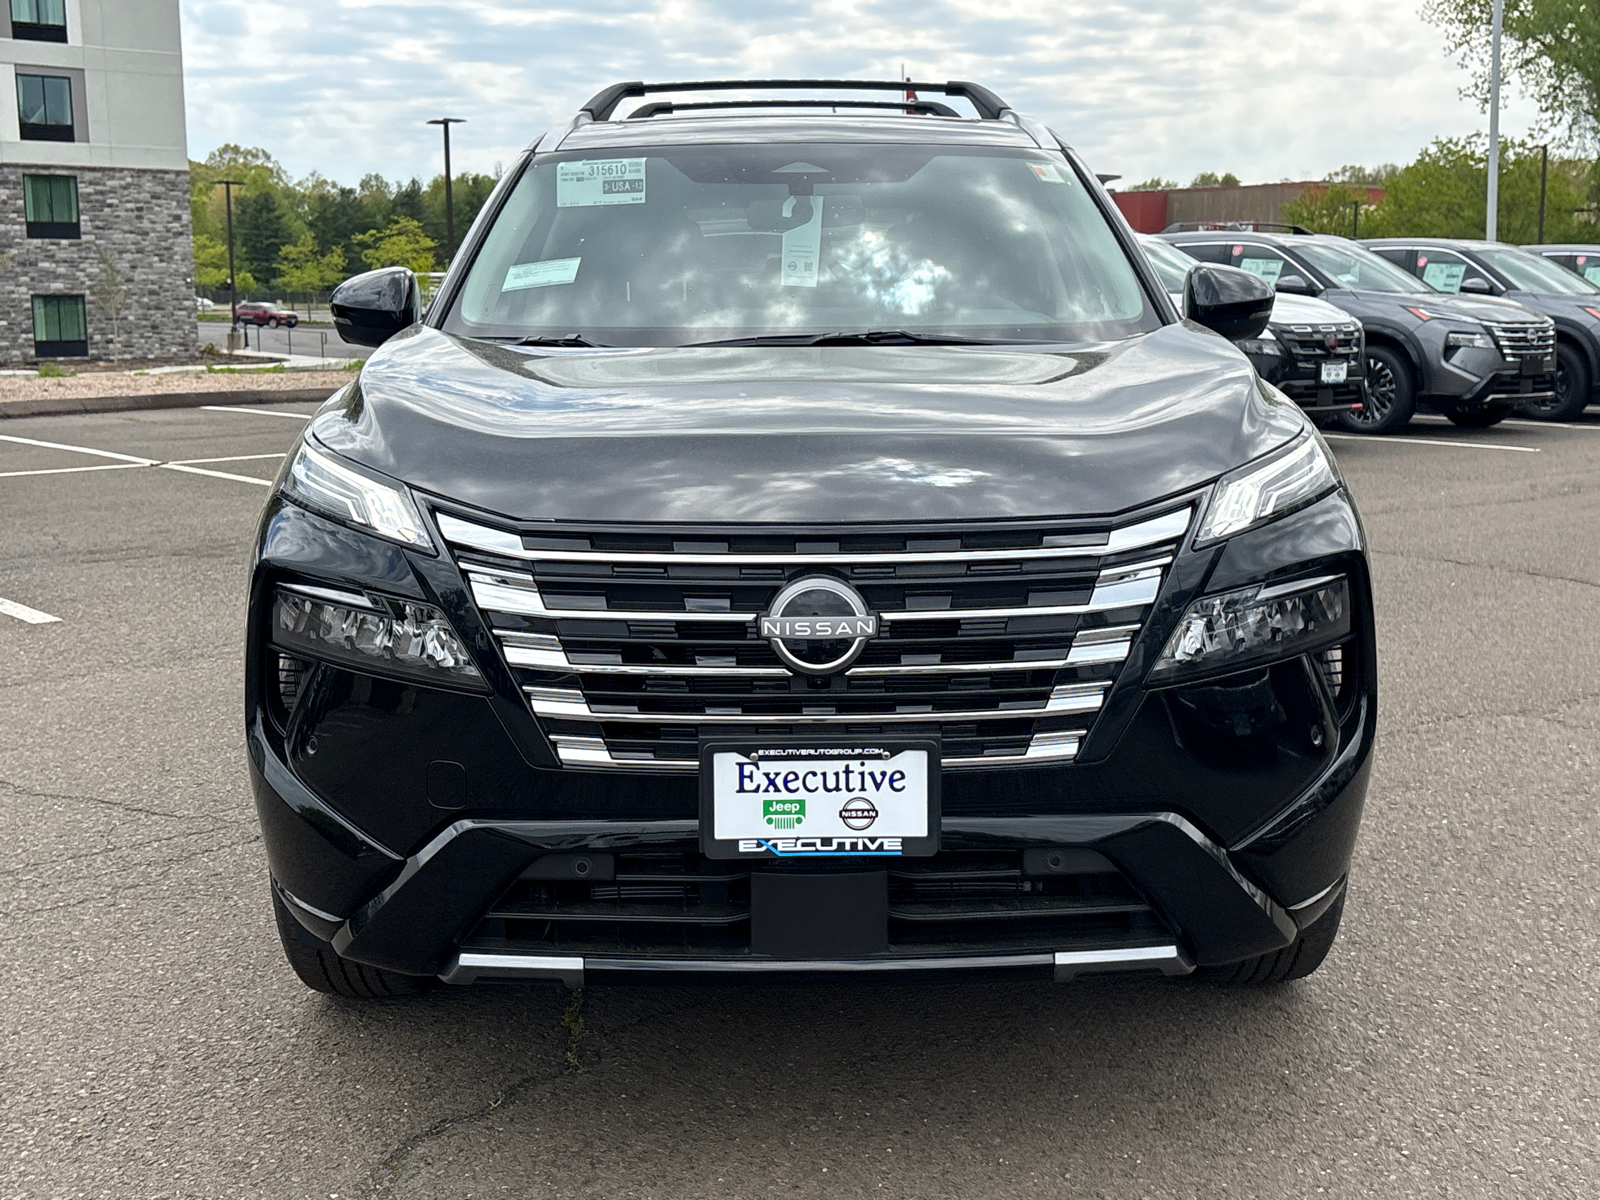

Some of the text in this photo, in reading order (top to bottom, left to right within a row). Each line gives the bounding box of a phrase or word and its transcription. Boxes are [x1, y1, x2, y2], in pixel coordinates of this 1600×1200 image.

[588, 163, 627, 177] 315610
[763, 620, 873, 636] NISSAN
[757, 748, 883, 756] EXECUTIVEAUTOGROUP.COM
[735, 761, 906, 794] Executive
[769, 801, 800, 814] Jeep
[841, 810, 877, 818] NISSAN
[738, 838, 903, 852] EXECUTIVE
